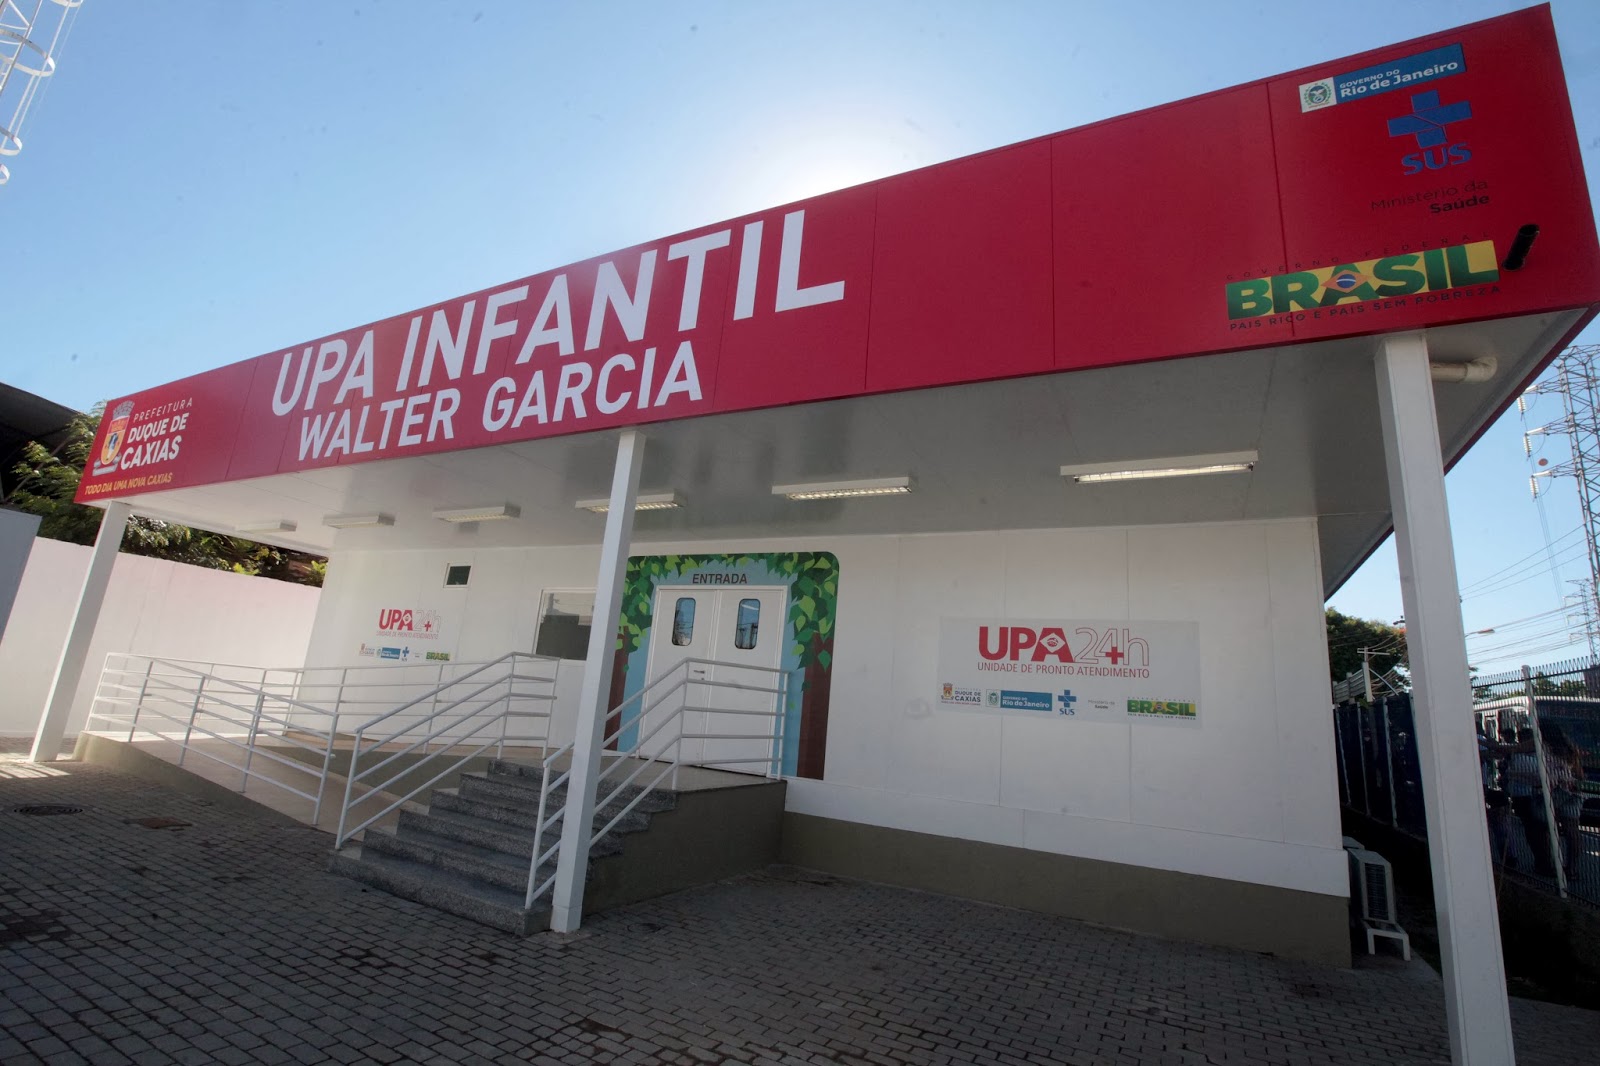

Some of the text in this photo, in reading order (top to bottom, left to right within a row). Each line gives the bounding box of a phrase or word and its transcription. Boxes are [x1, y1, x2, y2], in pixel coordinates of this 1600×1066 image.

[1340, 69, 1400, 88] GOVERNO DO
[1340, 62, 1458, 98] Rio de Janeiro
[1401, 142, 1472, 176] SUS
[1226, 241, 1500, 320] BRASIL
[272, 209, 845, 416] UPA INFANTIL
[1269, 313, 1306, 326] RICO
[1373, 300, 1407, 311] SEM
[1415, 286, 1500, 305] POBREZA
[133, 397, 193, 423] PREFEITURA
[298, 340, 703, 461] WALTER GARCIA
[127, 413, 190, 443] DUQUE DE
[120, 435, 182, 470] CAXIAS
[84, 482, 102, 495] TODO
[101, 481, 113, 492] DIA
[147, 472, 174, 486] CAXIAS
[692, 573, 748, 585] ENTRADA
[379, 608, 413, 631] UPA
[426, 652, 450, 661] BRASIL
[978, 626, 1073, 663] UPA
[977, 662, 1150, 679] UNIDADE DE PRONTO ATENDIMENTO
[955, 695, 981, 703] CAXIAS
[1023, 700, 1050, 709] Janeiro
[1127, 700, 1196, 716] BRASIL
[1059, 708, 1075, 716] SUS
